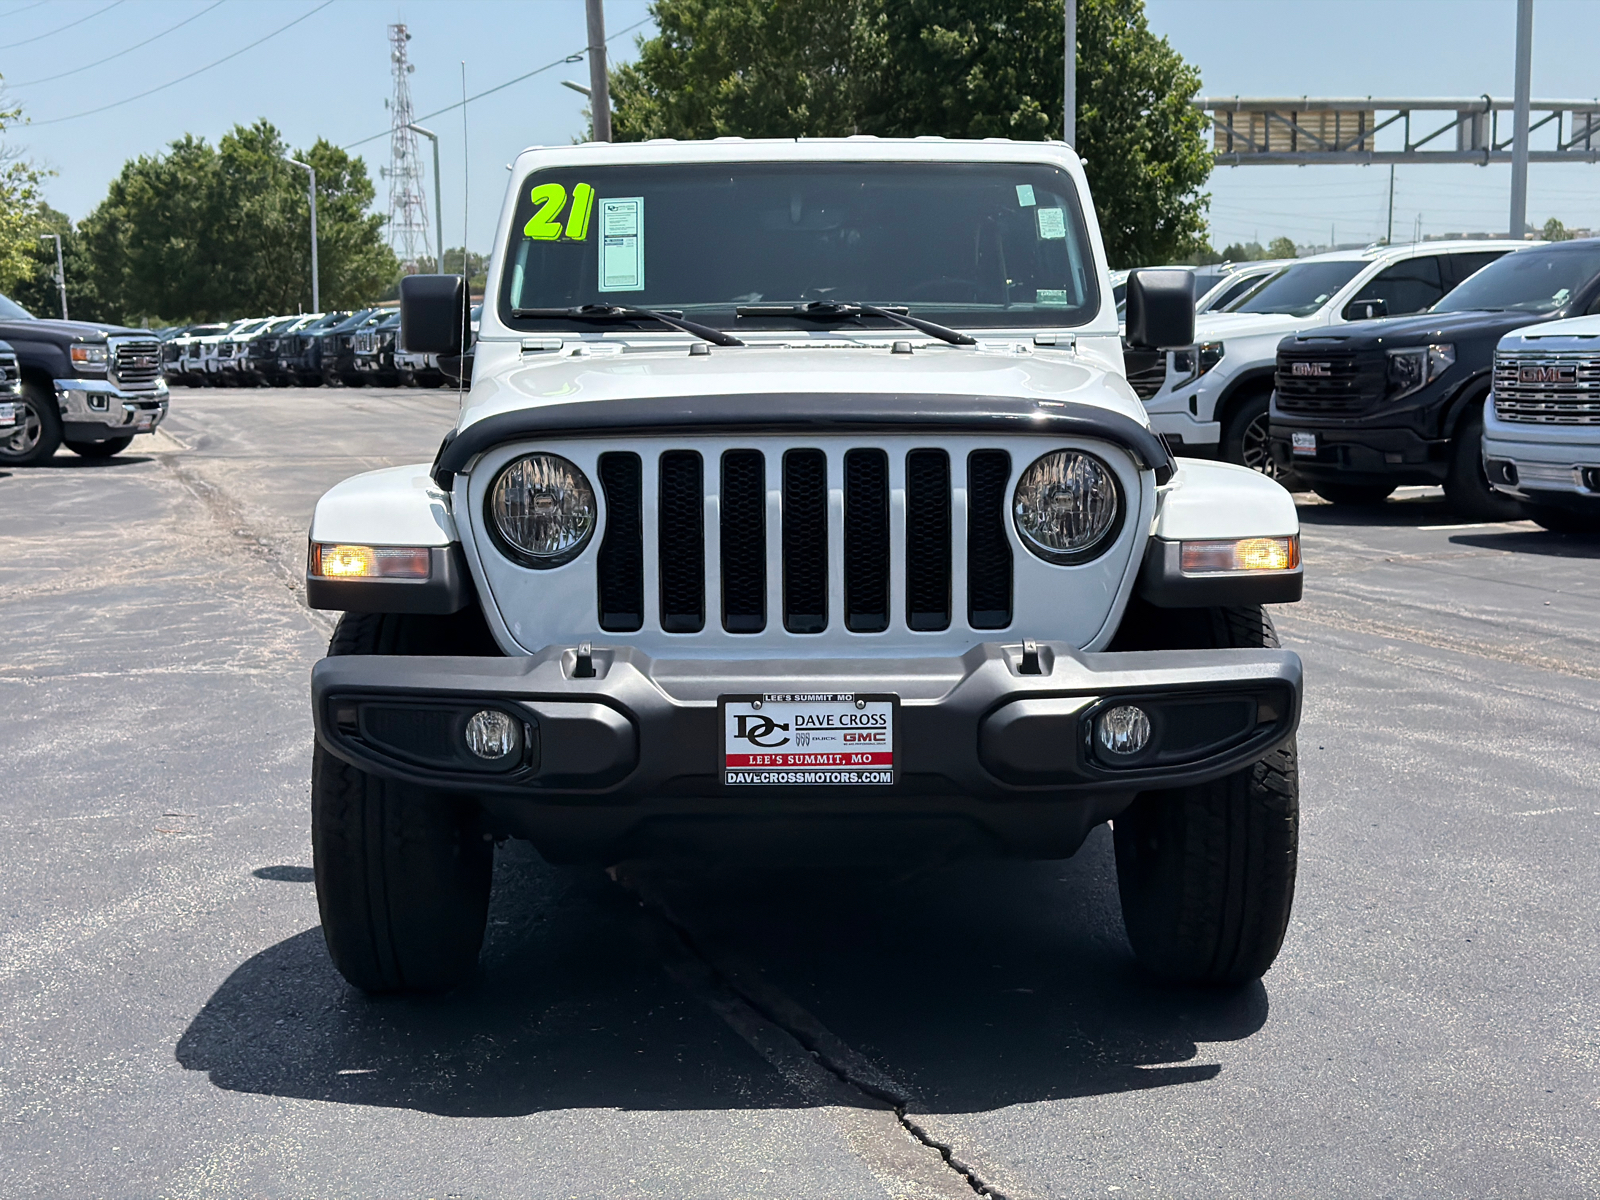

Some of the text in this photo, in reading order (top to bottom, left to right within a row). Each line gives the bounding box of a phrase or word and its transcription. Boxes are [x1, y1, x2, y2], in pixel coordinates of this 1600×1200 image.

[524, 183, 595, 240] 21
[1292, 362, 1331, 376] GMC
[1520, 366, 1575, 382] GMC
[794, 713, 887, 726] DAVE CROSS
[843, 732, 886, 742] GMC
[749, 753, 872, 765] LEE'S SUMMIT, MO
[727, 772, 891, 783] DAVECROSSMOTORS.COM
